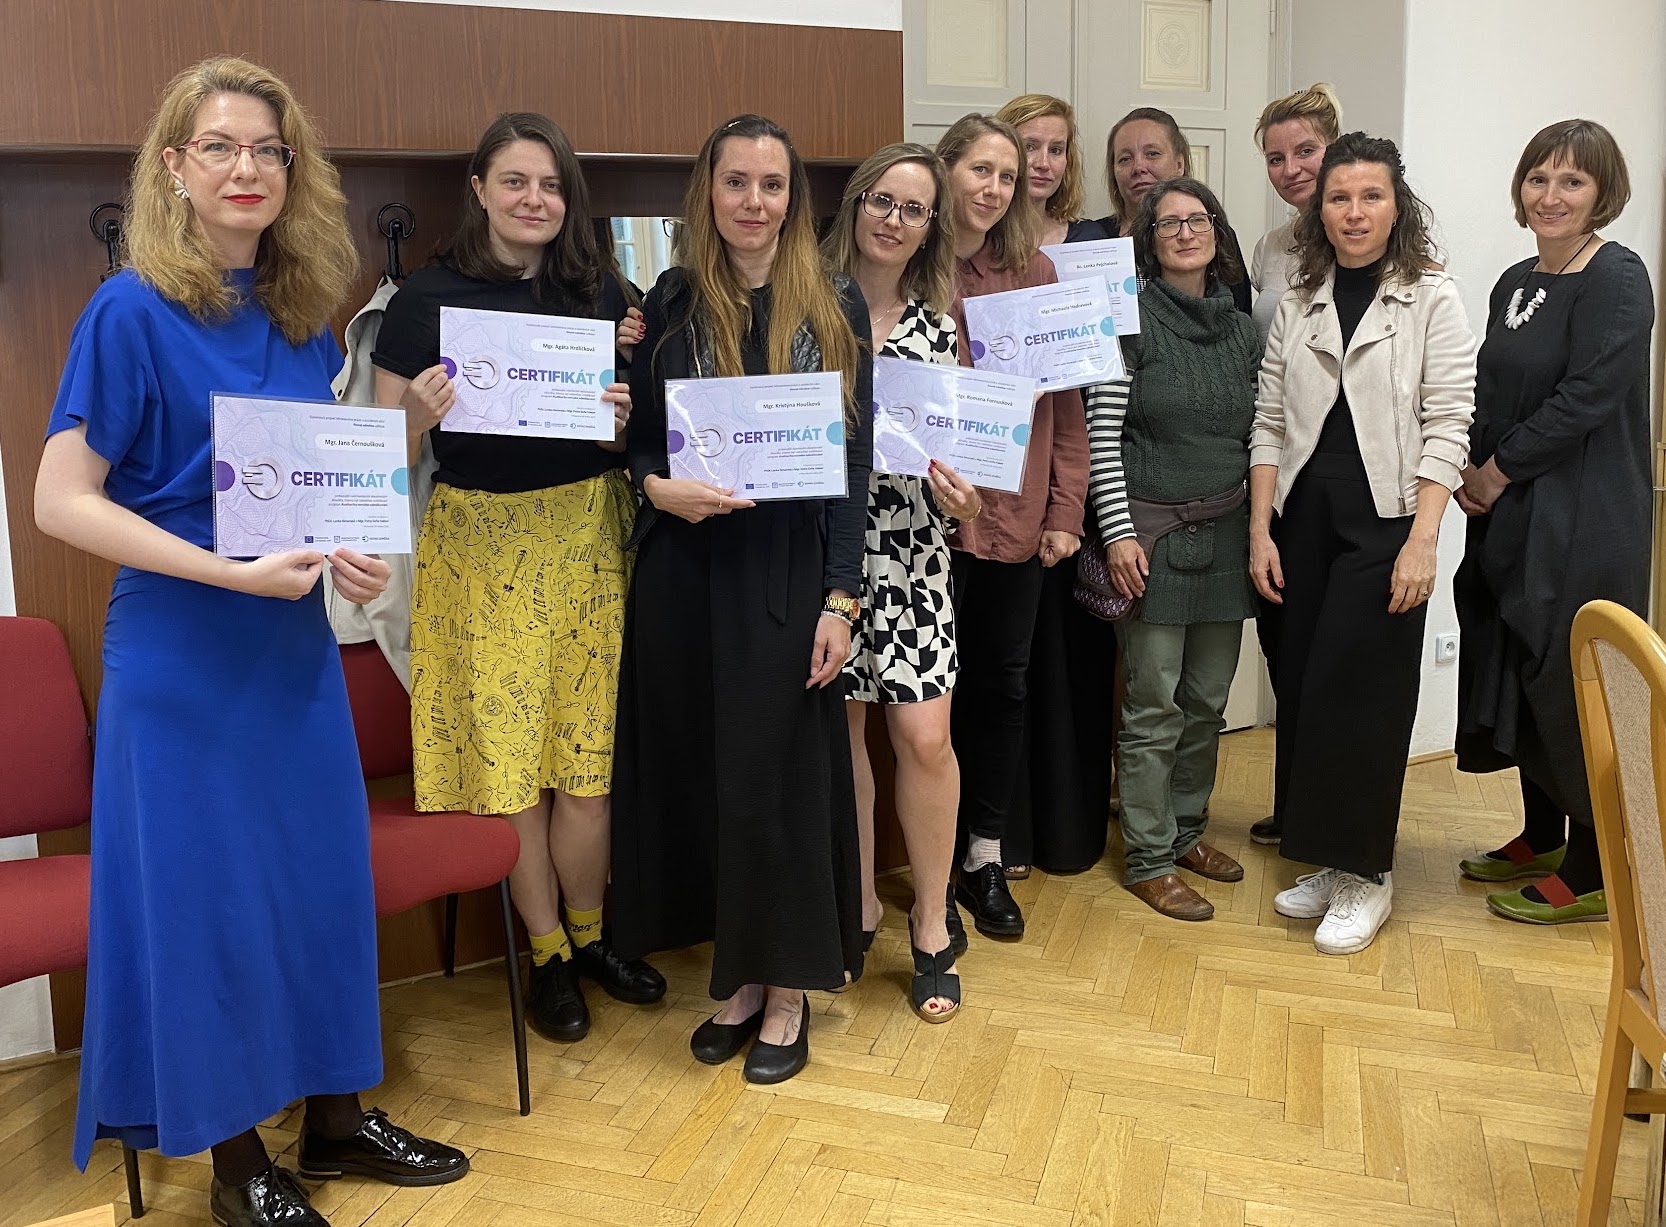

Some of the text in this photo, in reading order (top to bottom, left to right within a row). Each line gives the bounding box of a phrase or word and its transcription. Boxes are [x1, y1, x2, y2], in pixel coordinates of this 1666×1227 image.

[1024, 322, 1097, 347] CERTIFIKÁT
[555, 343, 569, 352] Agáta
[507, 367, 596, 385] CERTIFIKÁT
[775, 402, 796, 410] Kristýna
[966, 394, 986, 402] Romana
[732, 425, 822, 445] CERTIFIKÁT
[925, 414, 1010, 438] CERTIFIKÁT
[324, 439, 385, 449] Mgr. Jana Černoušková
[290, 469, 387, 488] CERTIFIKÁT
